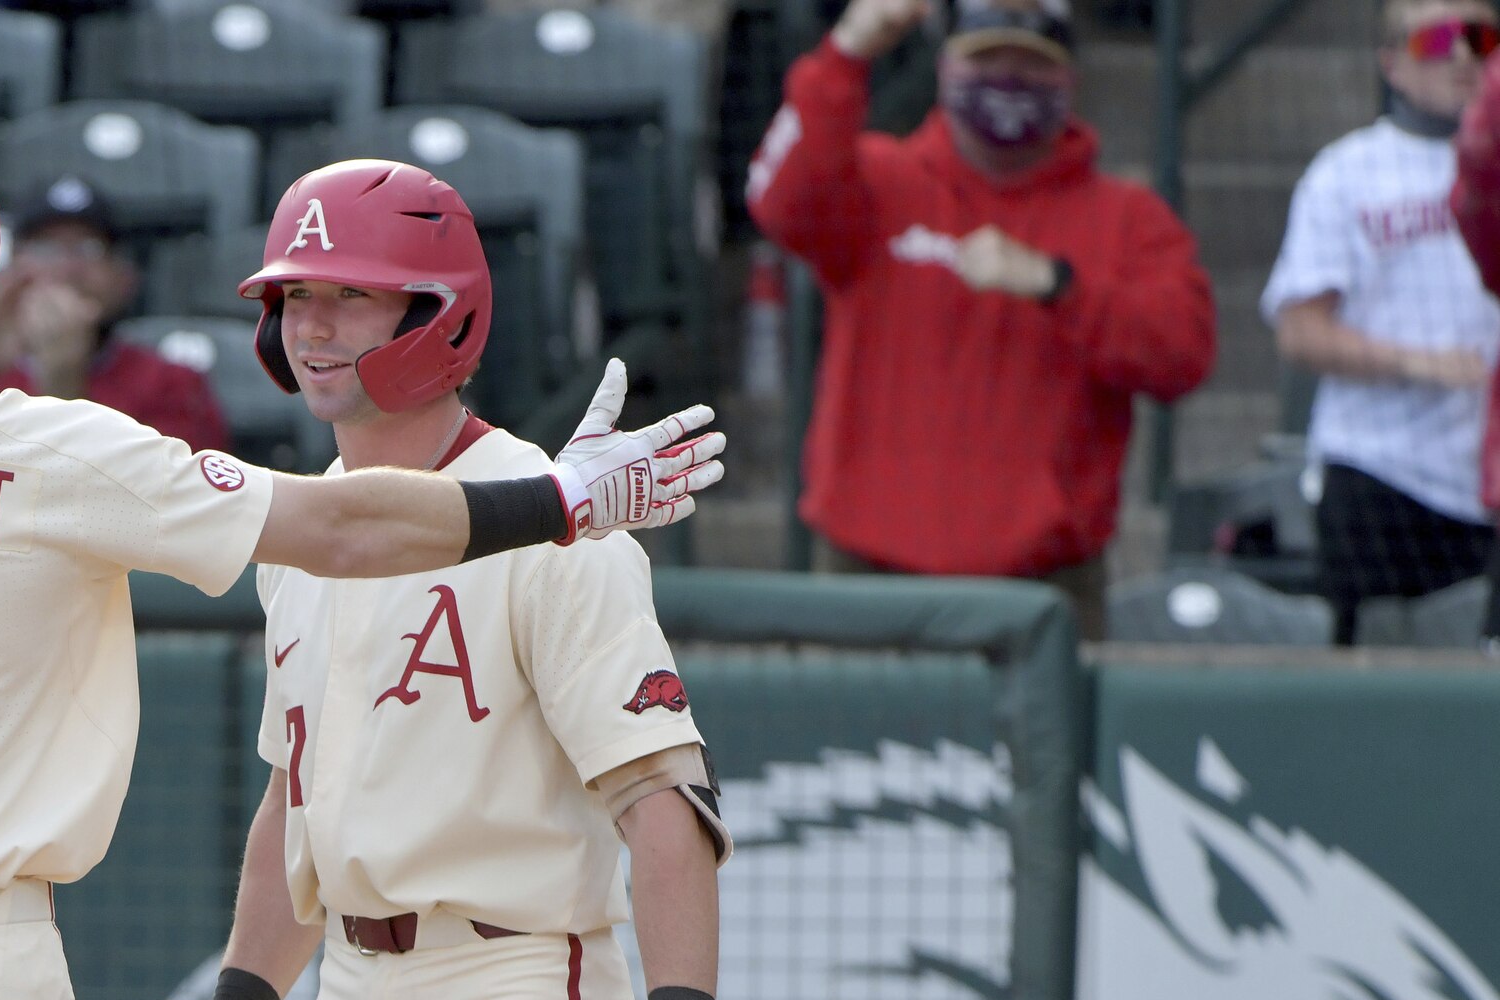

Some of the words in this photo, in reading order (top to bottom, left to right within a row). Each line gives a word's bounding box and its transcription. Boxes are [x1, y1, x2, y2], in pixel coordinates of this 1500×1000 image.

[284, 198, 335, 256] A
[373, 584, 490, 722] A
[285, 705, 306, 808] 7
